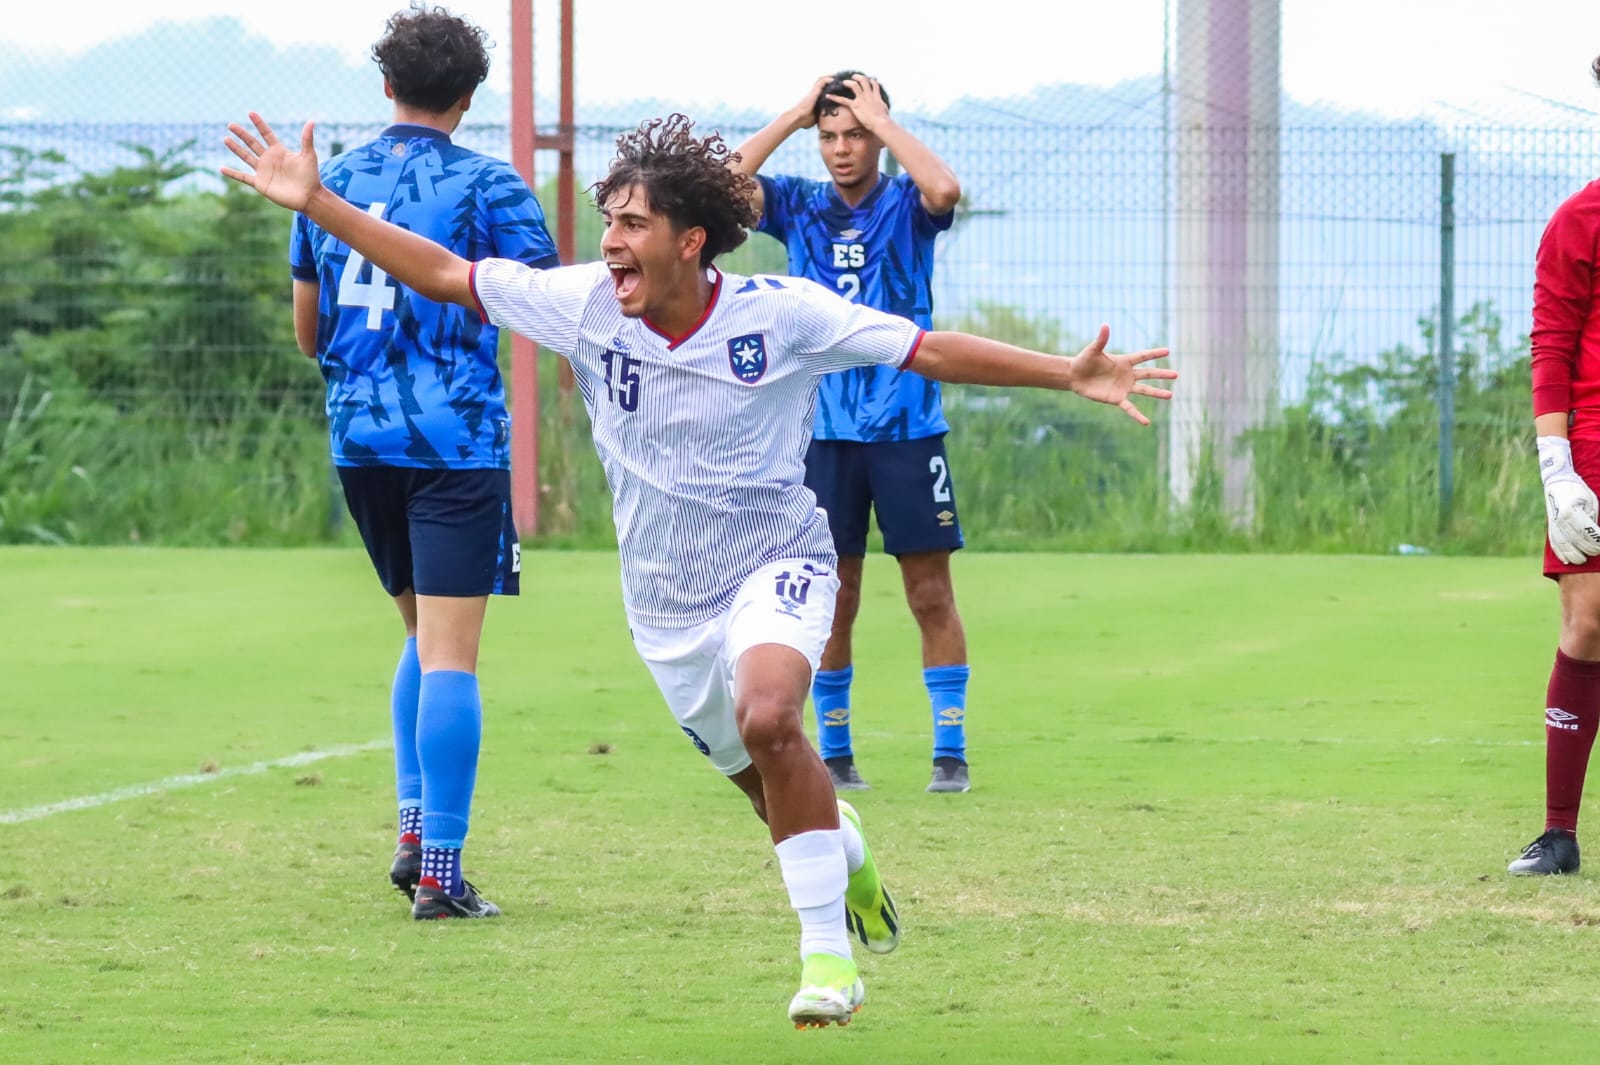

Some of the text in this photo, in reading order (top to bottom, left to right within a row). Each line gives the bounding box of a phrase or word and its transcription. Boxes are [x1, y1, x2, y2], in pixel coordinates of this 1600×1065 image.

[337, 202, 396, 331] 4
[832, 243, 865, 268] ES
[837, 273, 860, 301] 2
[600, 348, 642, 412] 15
[929, 455, 951, 503] 2
